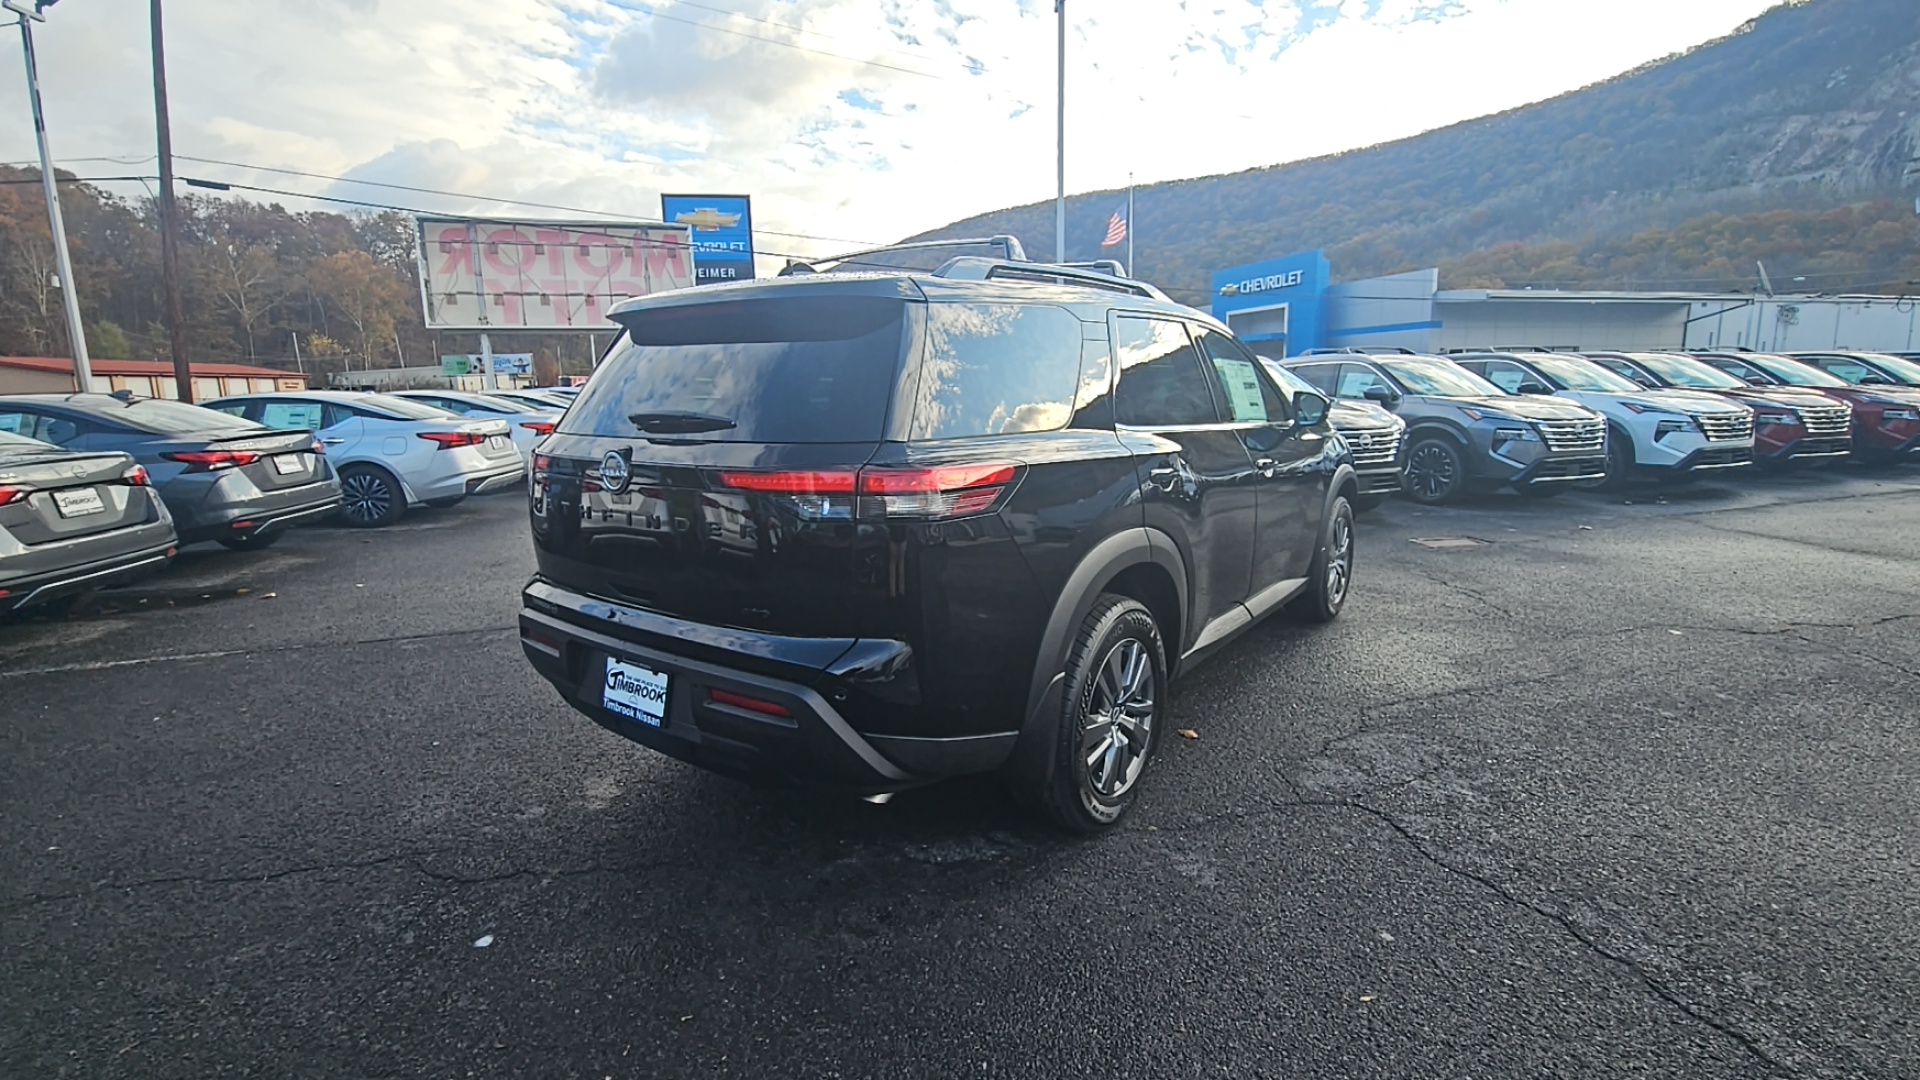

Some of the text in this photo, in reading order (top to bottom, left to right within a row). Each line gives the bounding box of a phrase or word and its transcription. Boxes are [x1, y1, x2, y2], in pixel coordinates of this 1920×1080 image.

[692, 241, 745, 253] EVROLET
[696, 267, 736, 279] EIMER
[1240, 270, 1304, 294] CHEVROLET
[599, 466, 628, 477] NISSAN
[606, 667, 667, 704] TIMBROOK
[603, 697, 661, 728] Timbrook Nissan
